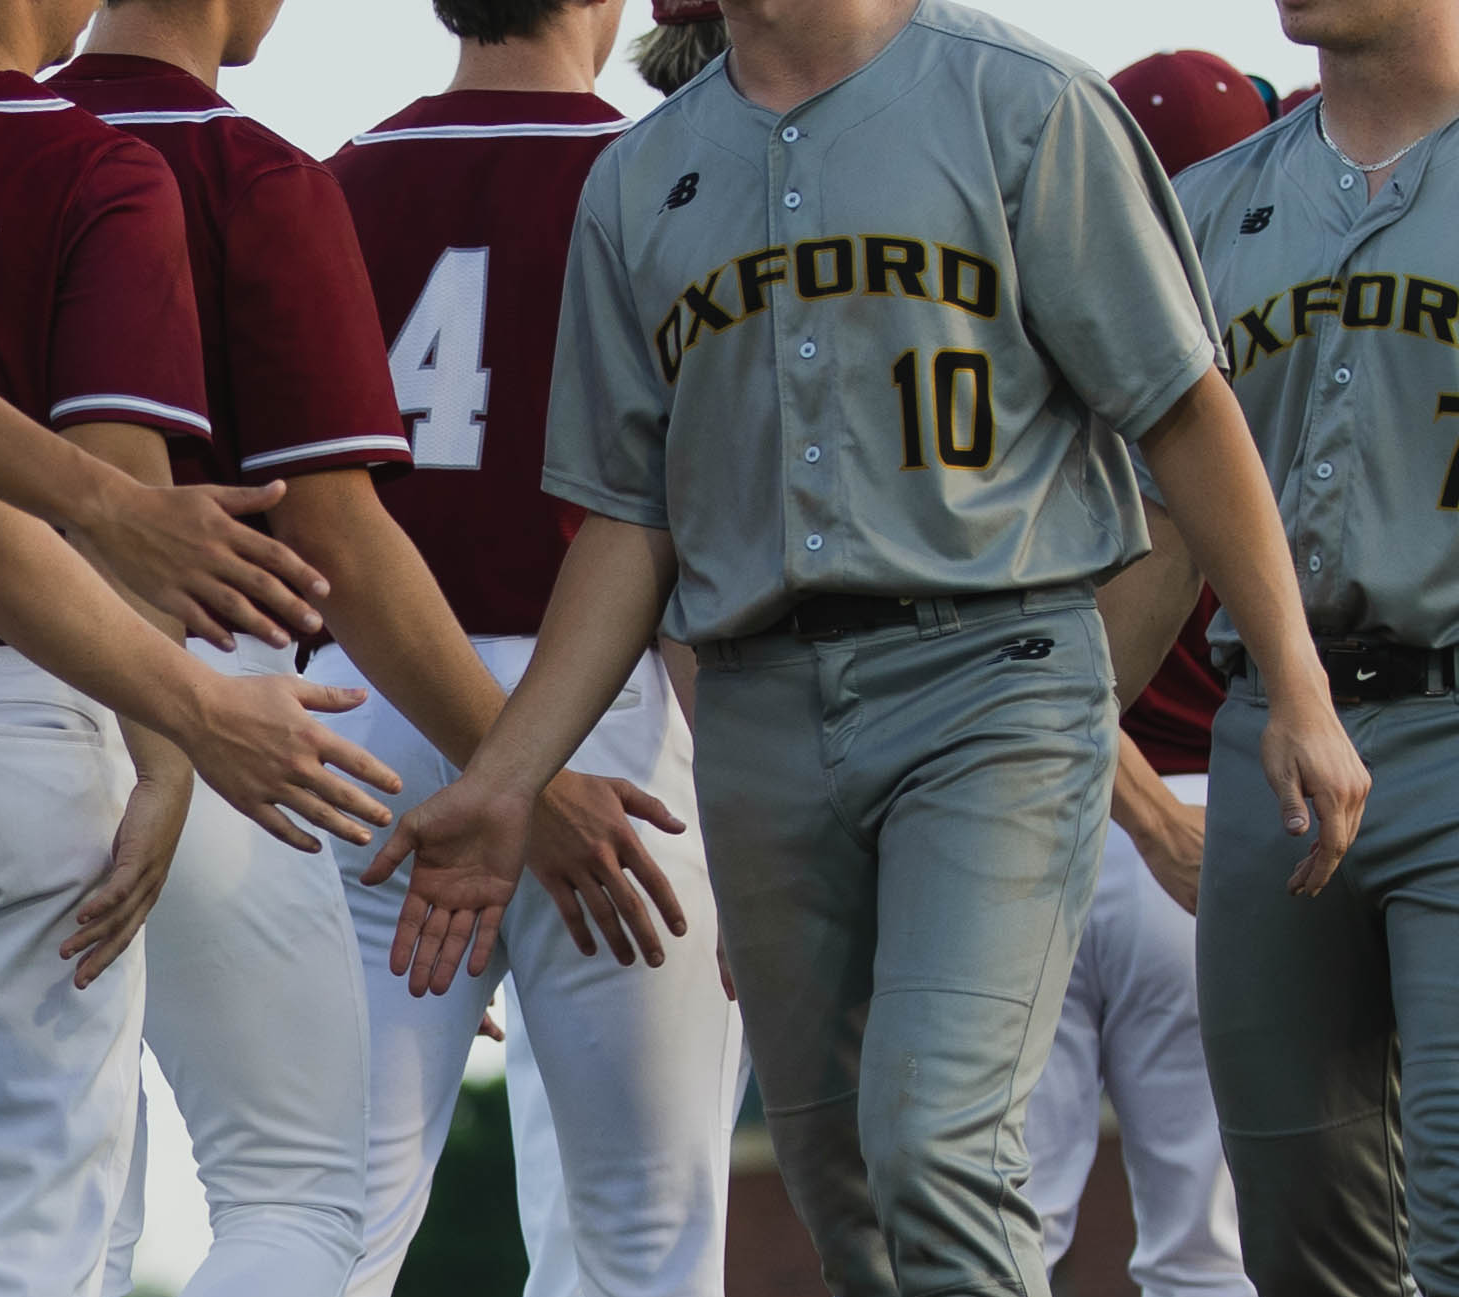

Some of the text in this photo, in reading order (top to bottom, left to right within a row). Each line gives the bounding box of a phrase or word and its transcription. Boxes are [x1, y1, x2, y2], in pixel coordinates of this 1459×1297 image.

[386, 245, 492, 471] 4
[655, 233, 1001, 386] OXFORD
[891, 347, 995, 471] 10
